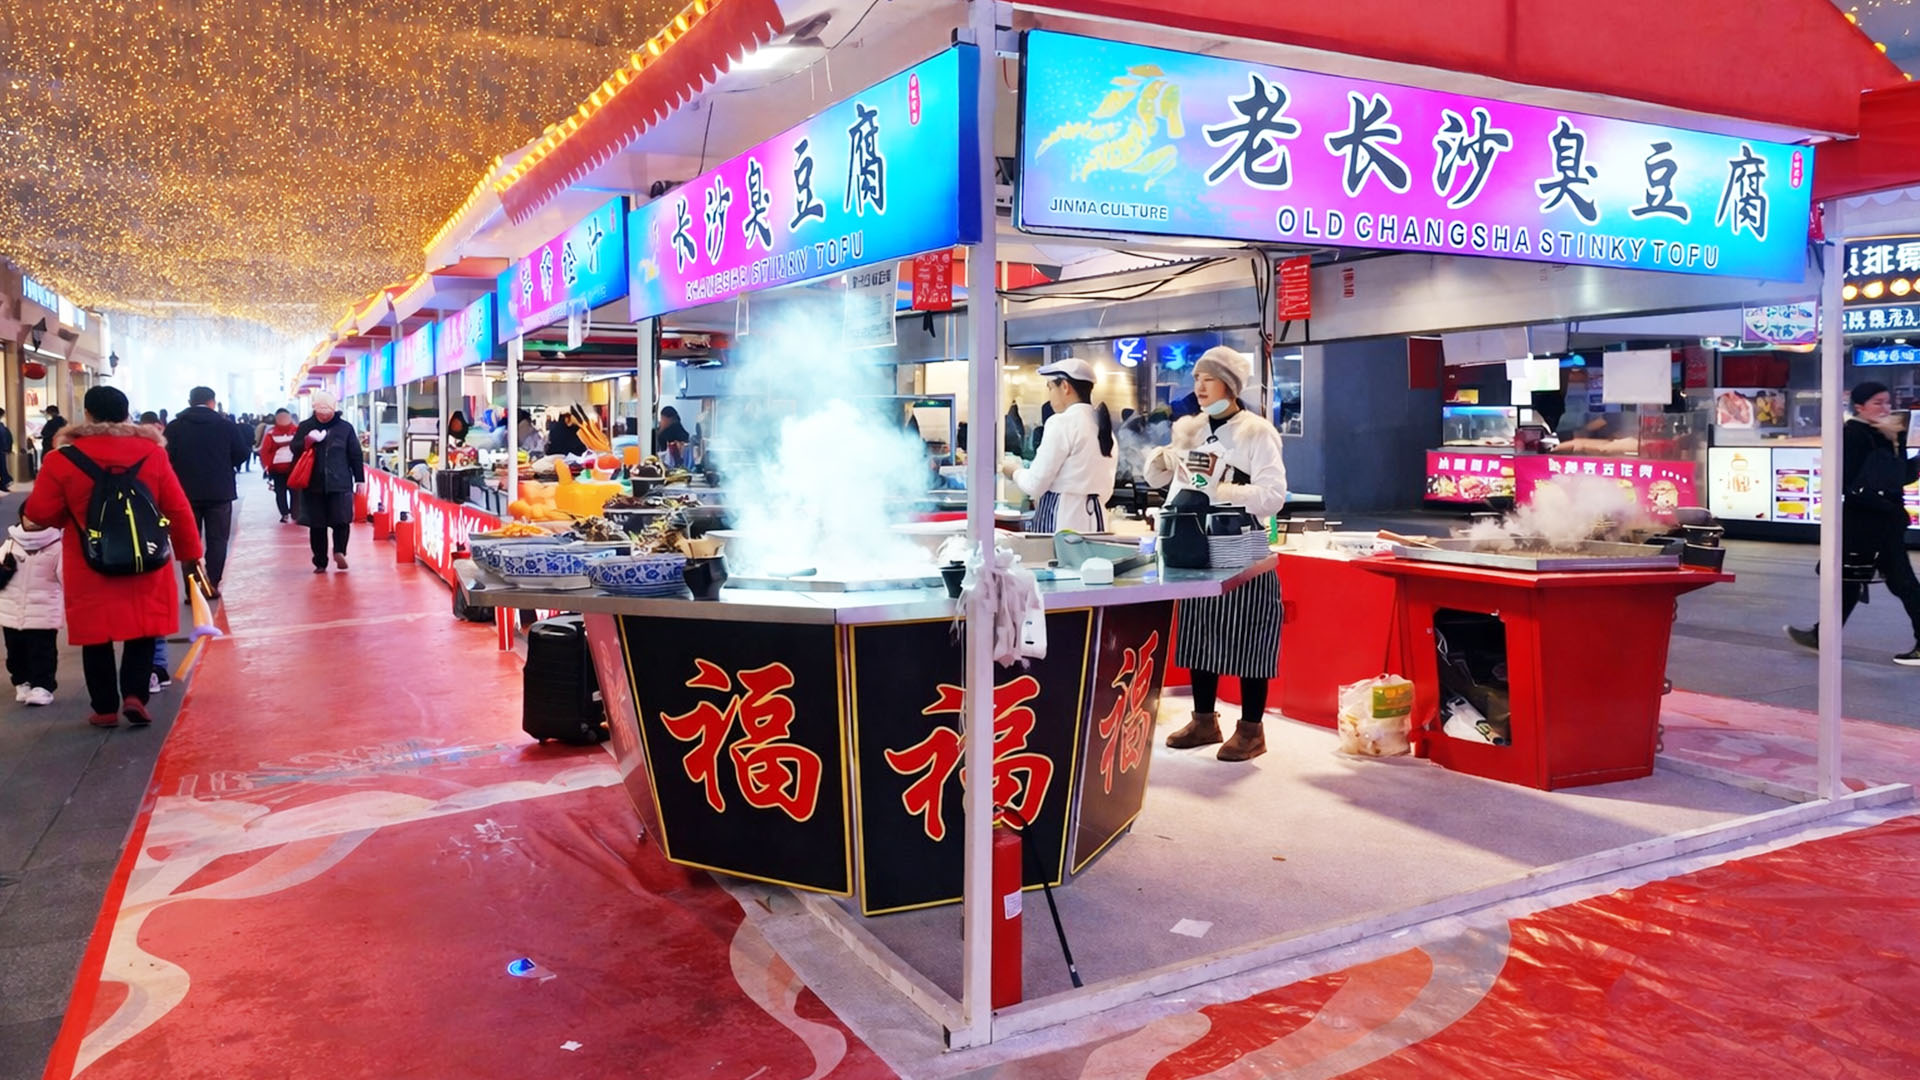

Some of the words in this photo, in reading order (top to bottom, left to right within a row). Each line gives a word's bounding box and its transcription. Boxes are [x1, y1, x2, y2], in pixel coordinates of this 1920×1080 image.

[672, 104, 885, 273] 长沙臭豆腐
[1049, 198, 1098, 214] JINMA
[1100, 202, 1168, 220] CULTURE
[1205, 72, 1769, 240] 老长沙臭豆腐
[814, 231, 863, 270] TOFU
[1278, 208, 1344, 237] OLD
[1356, 212, 1531, 254] CHANGSHA
[1539, 231, 1647, 263] STINKY
[1652, 240, 1719, 269] TOFU
[660, 658, 822, 822] 福
[884, 675, 1054, 842] 福
[1099, 630, 1158, 795] 福
